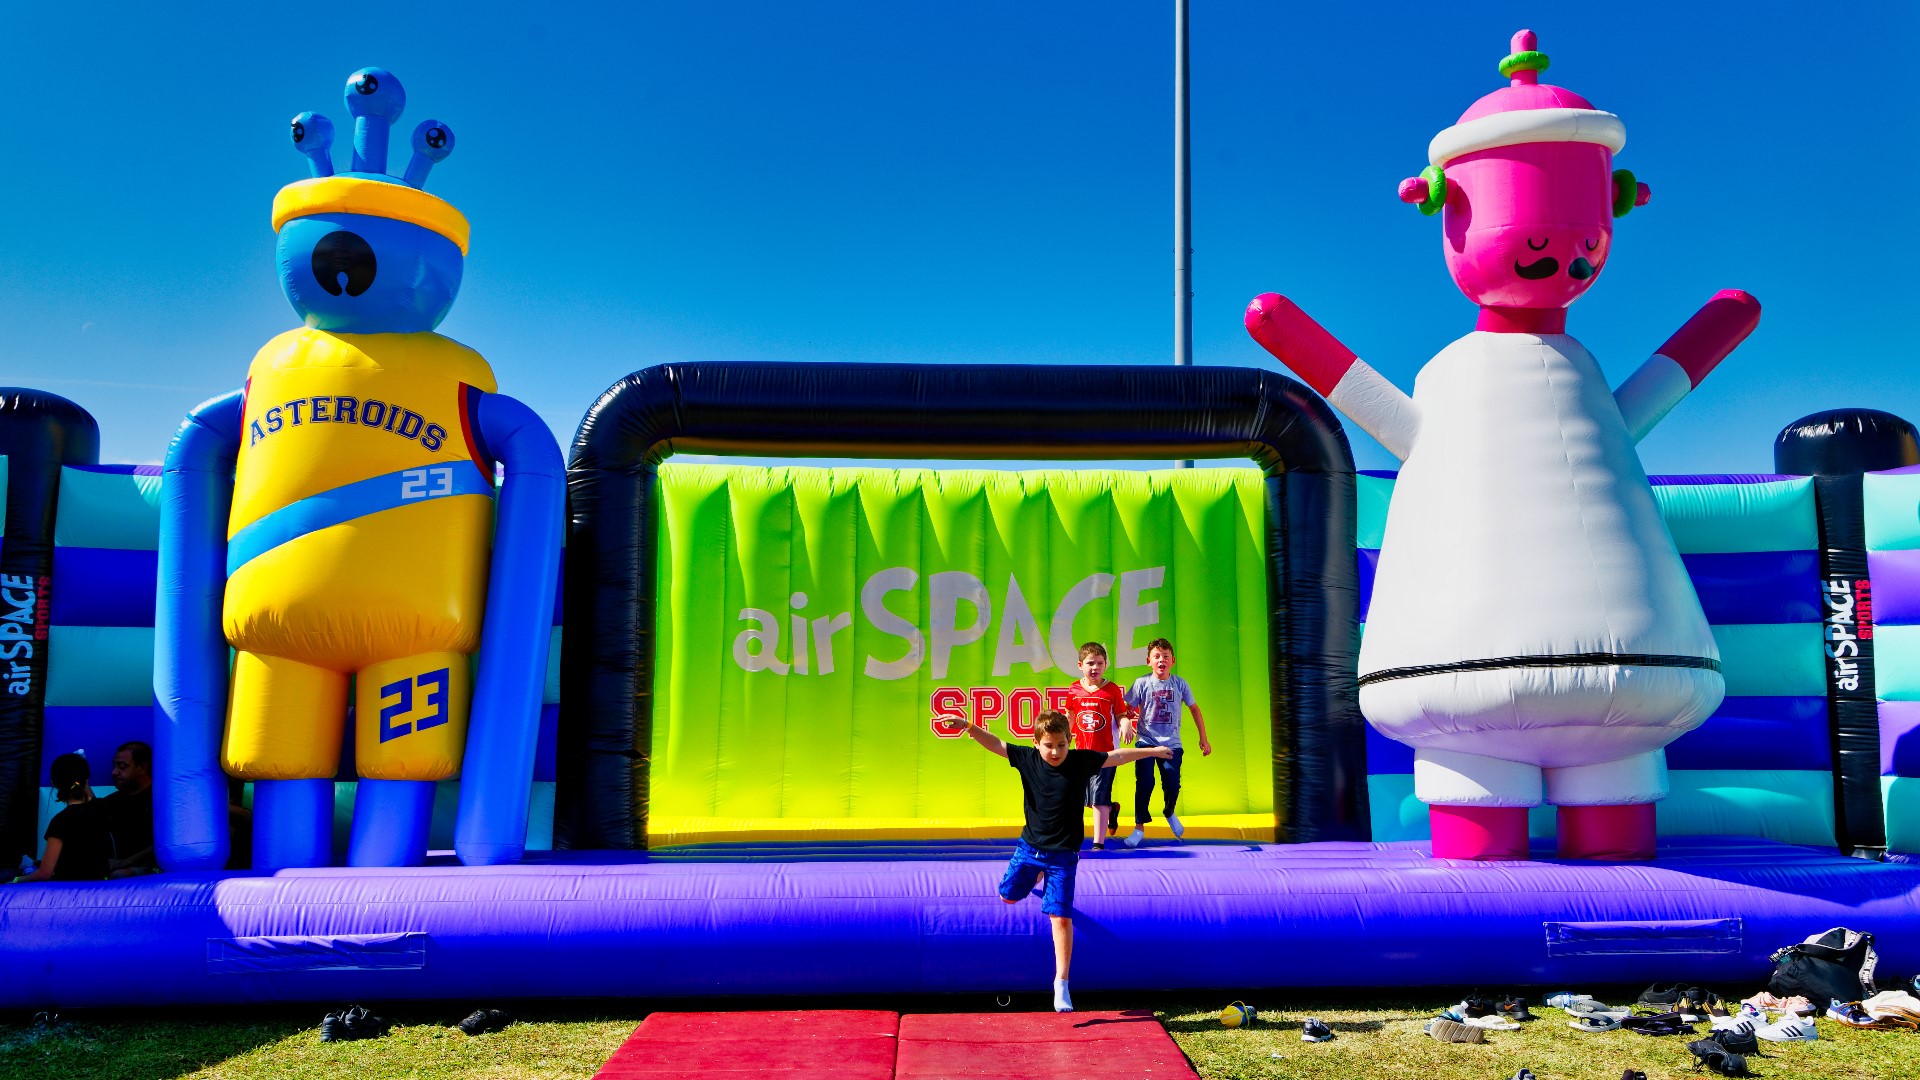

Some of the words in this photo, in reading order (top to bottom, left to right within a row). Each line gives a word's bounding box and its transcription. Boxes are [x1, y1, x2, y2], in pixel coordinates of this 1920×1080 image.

[249, 395, 449, 453] ASTEROIDS
[401, 467, 453, 500] 23
[35, 576, 51, 640] SPORTS
[1855, 580, 1872, 639] SPORTS
[379, 667, 450, 744] 23
